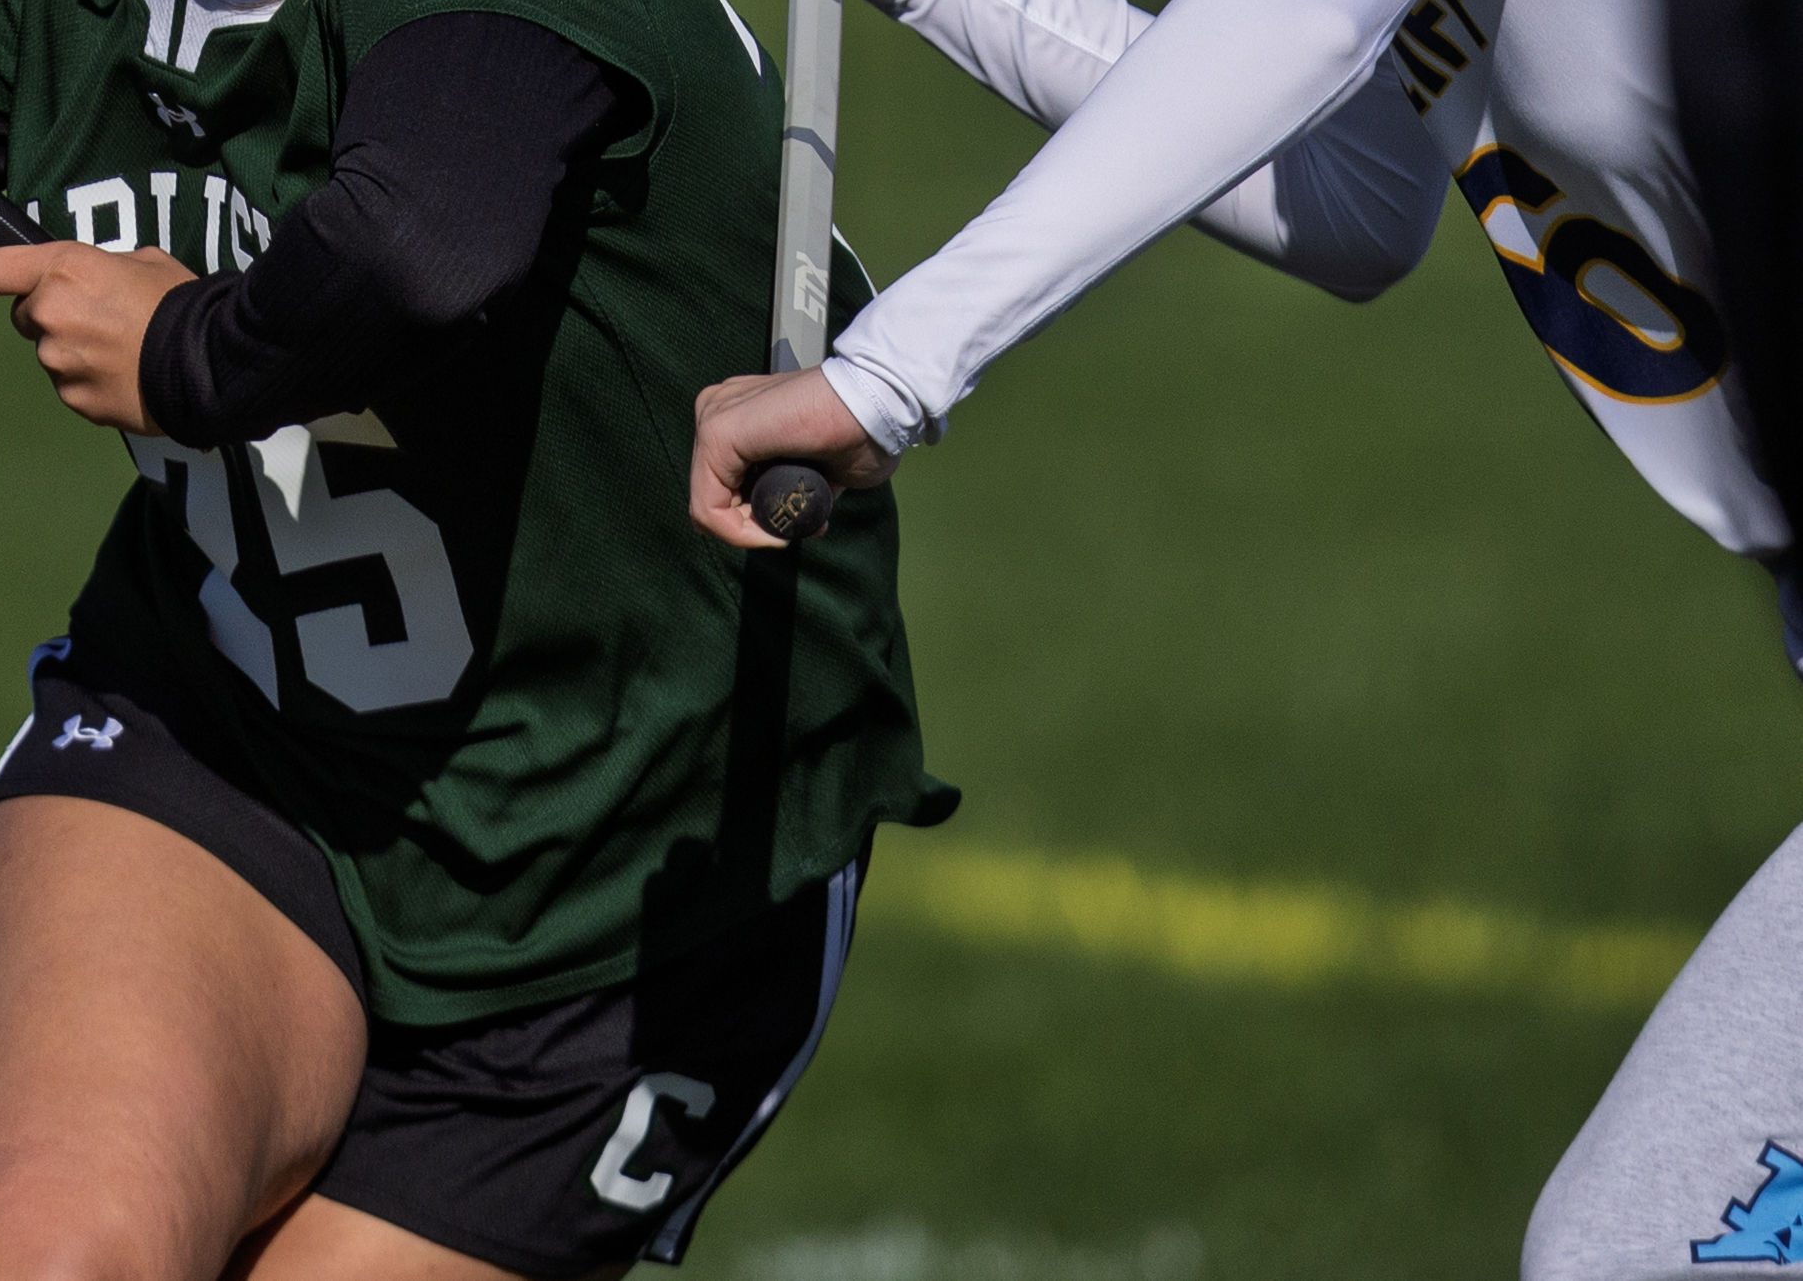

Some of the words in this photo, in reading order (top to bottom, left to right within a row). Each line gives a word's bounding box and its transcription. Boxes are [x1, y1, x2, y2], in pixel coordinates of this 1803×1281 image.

[793, 250, 828, 328] STX
[1451, 143, 1730, 405] 6
[769, 476, 817, 533] STX
[590, 1072, 717, 1212] C
